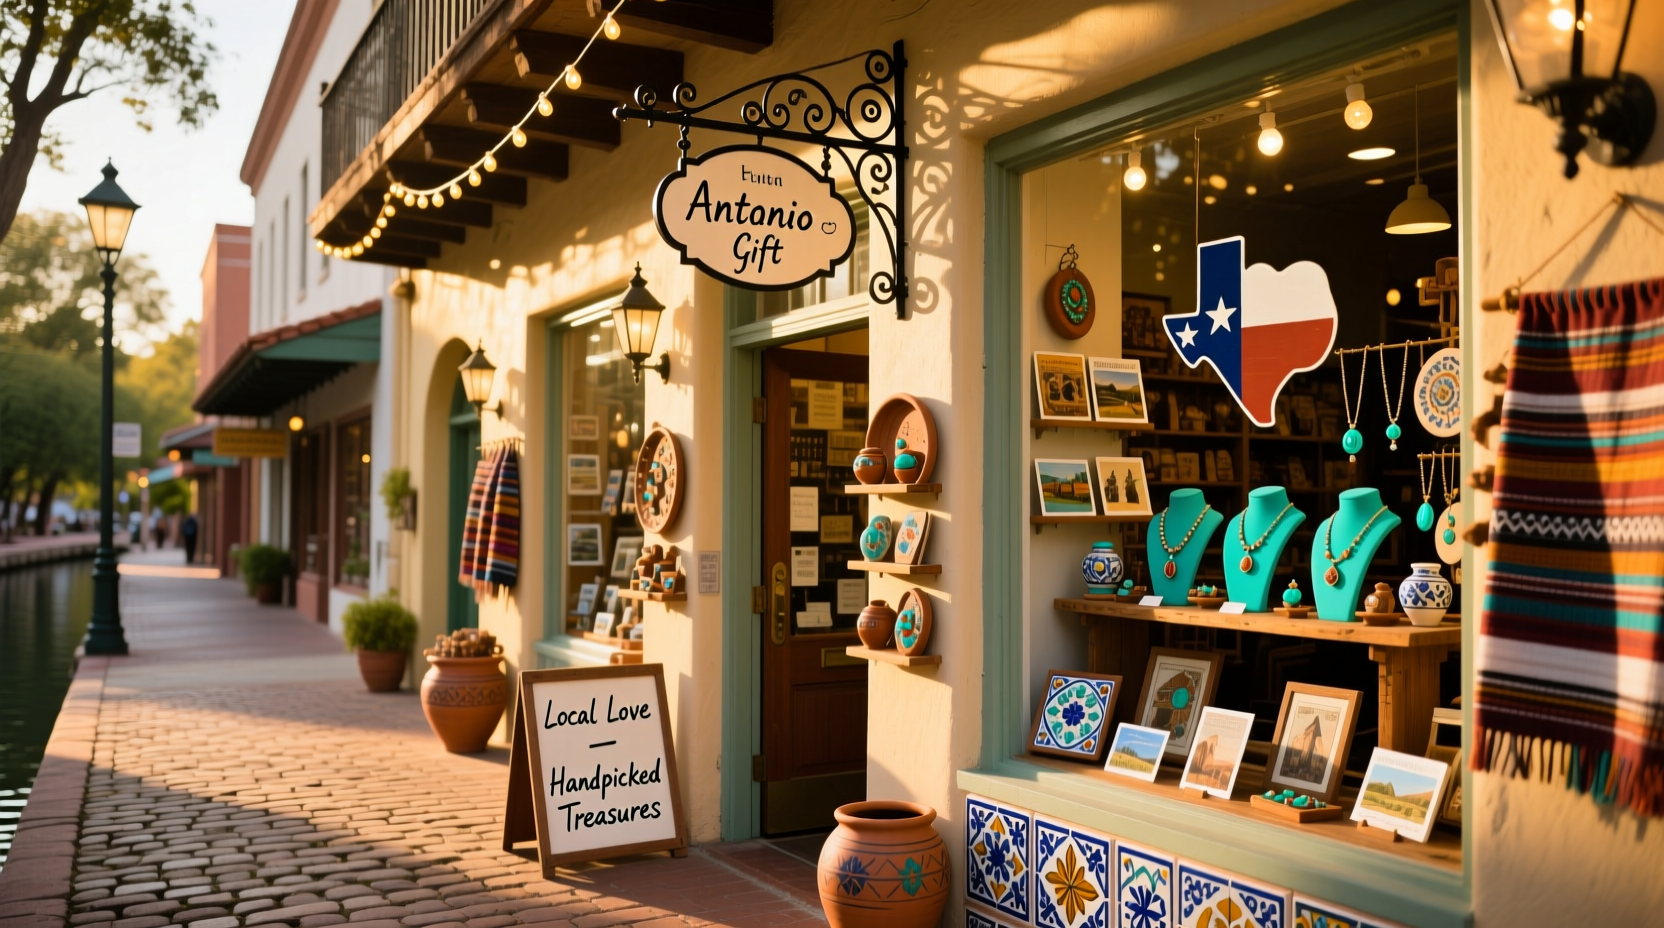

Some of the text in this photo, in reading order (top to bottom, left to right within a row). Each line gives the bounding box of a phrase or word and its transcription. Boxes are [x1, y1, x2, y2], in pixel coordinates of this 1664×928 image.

[732, 231, 784, 275] Gift
[544, 694, 651, 729] Local Love
[550, 757, 661, 800] Handpicked
[557, 801, 661, 832] Treasures
